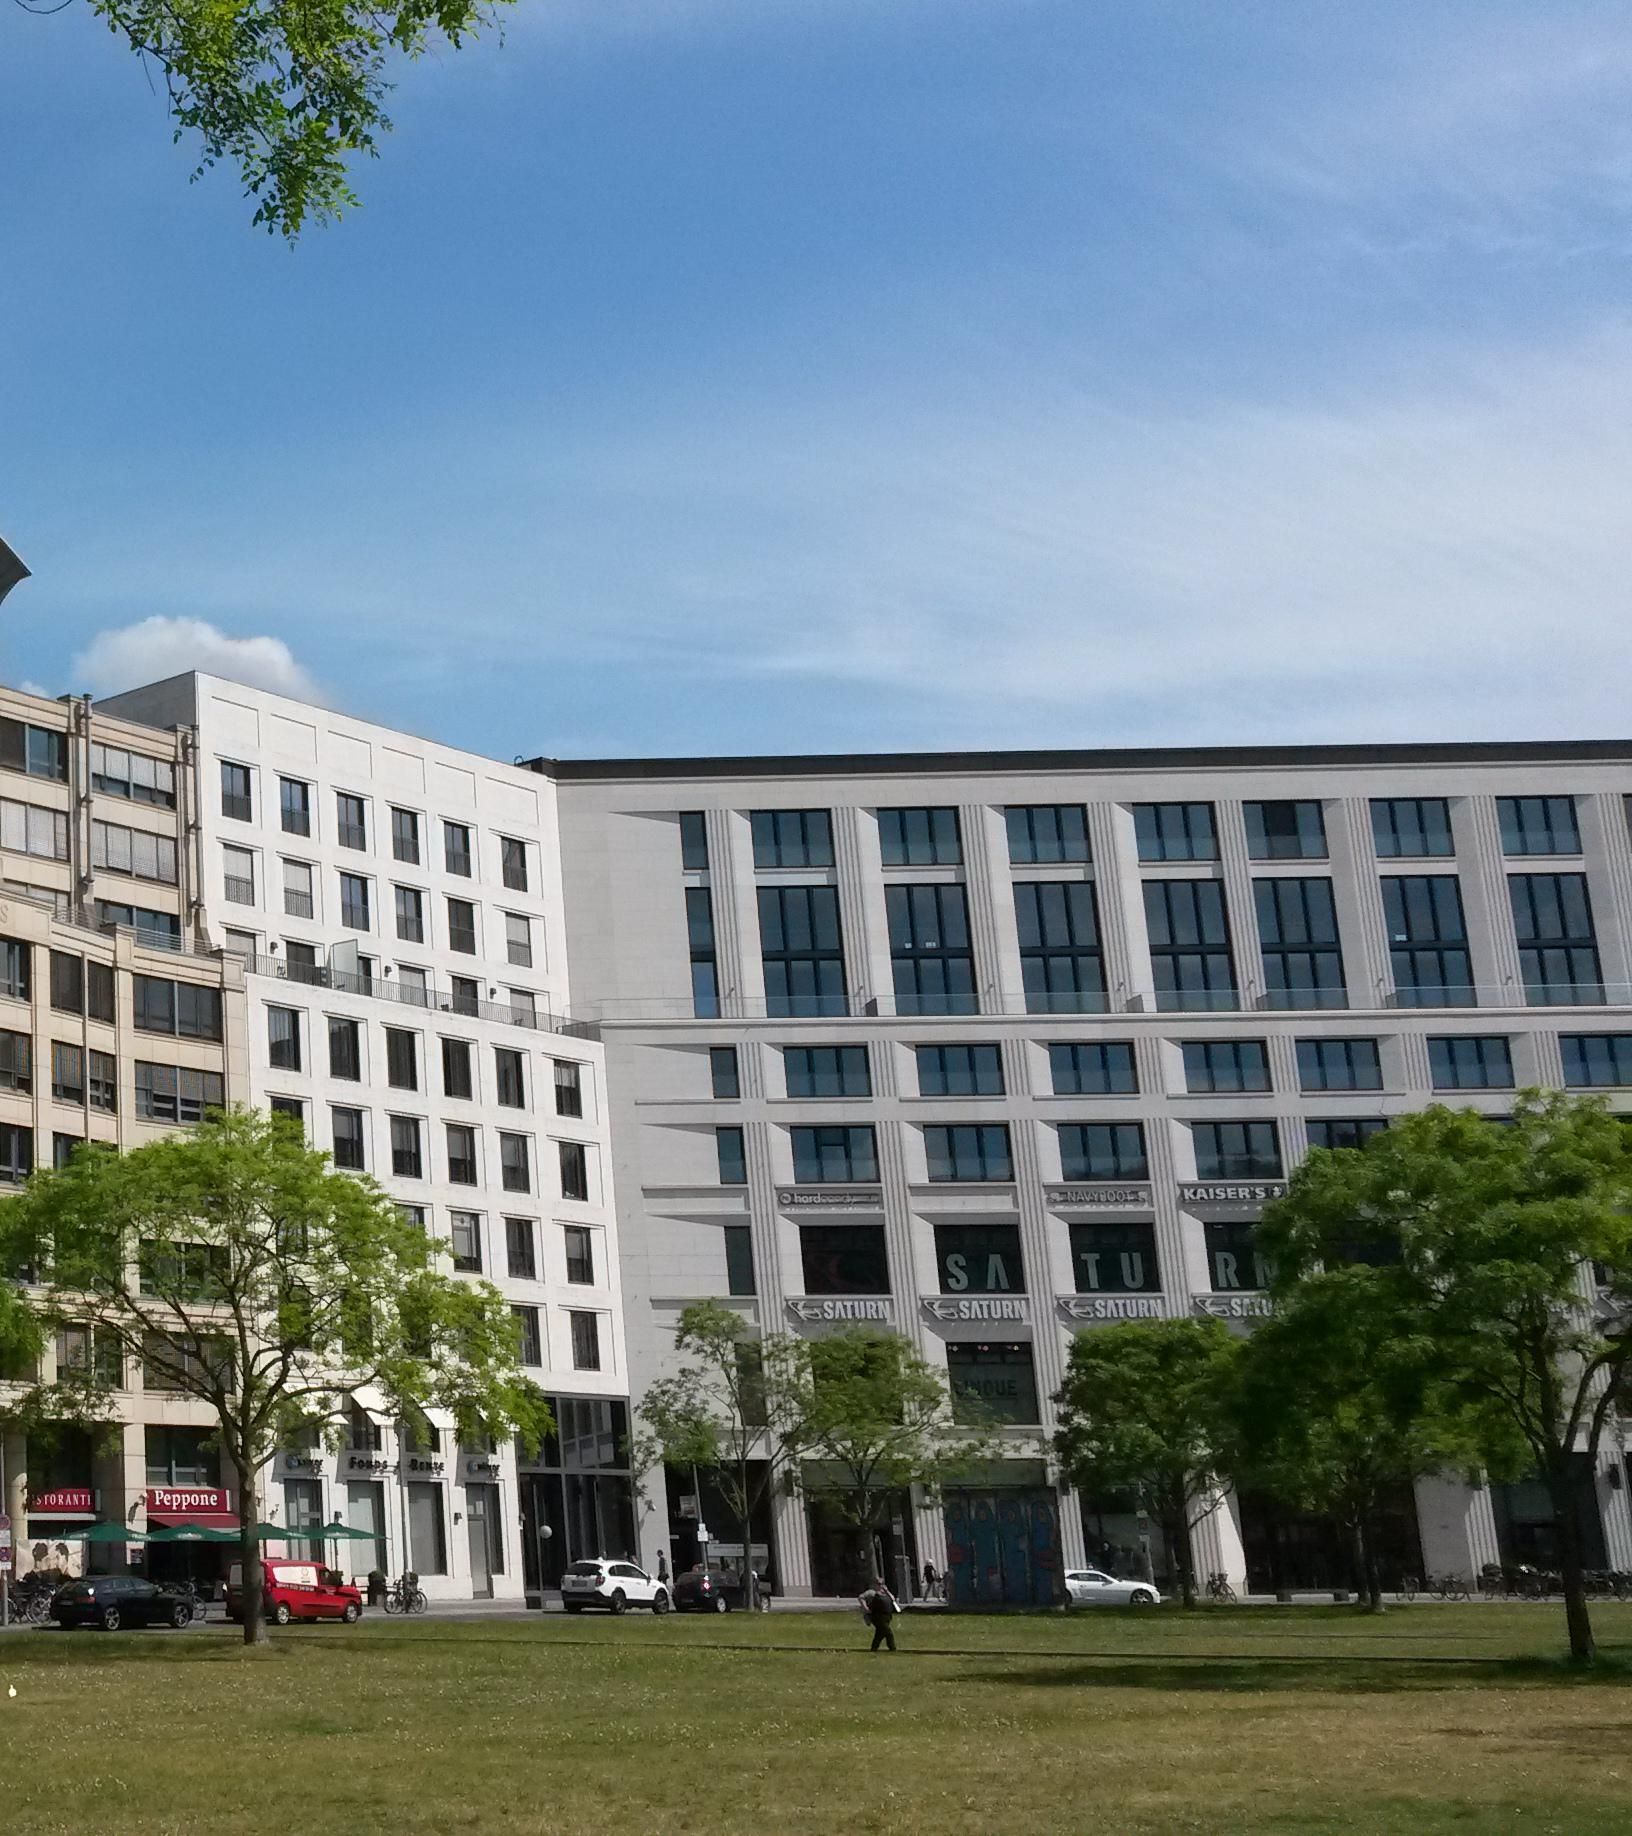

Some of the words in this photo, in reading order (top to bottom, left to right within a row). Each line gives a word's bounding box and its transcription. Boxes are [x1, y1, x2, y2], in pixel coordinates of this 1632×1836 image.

[1068, 1190, 1135, 1202] NAVYBOOT
[1183, 1186, 1266, 1200] KAISER'S
[823, 1300, 890, 1320] SATURN
[958, 1299, 1027, 1320] SATURN
[1095, 1298, 1163, 1320] SATURN
[154, 1490, 218, 1510] Peppone
